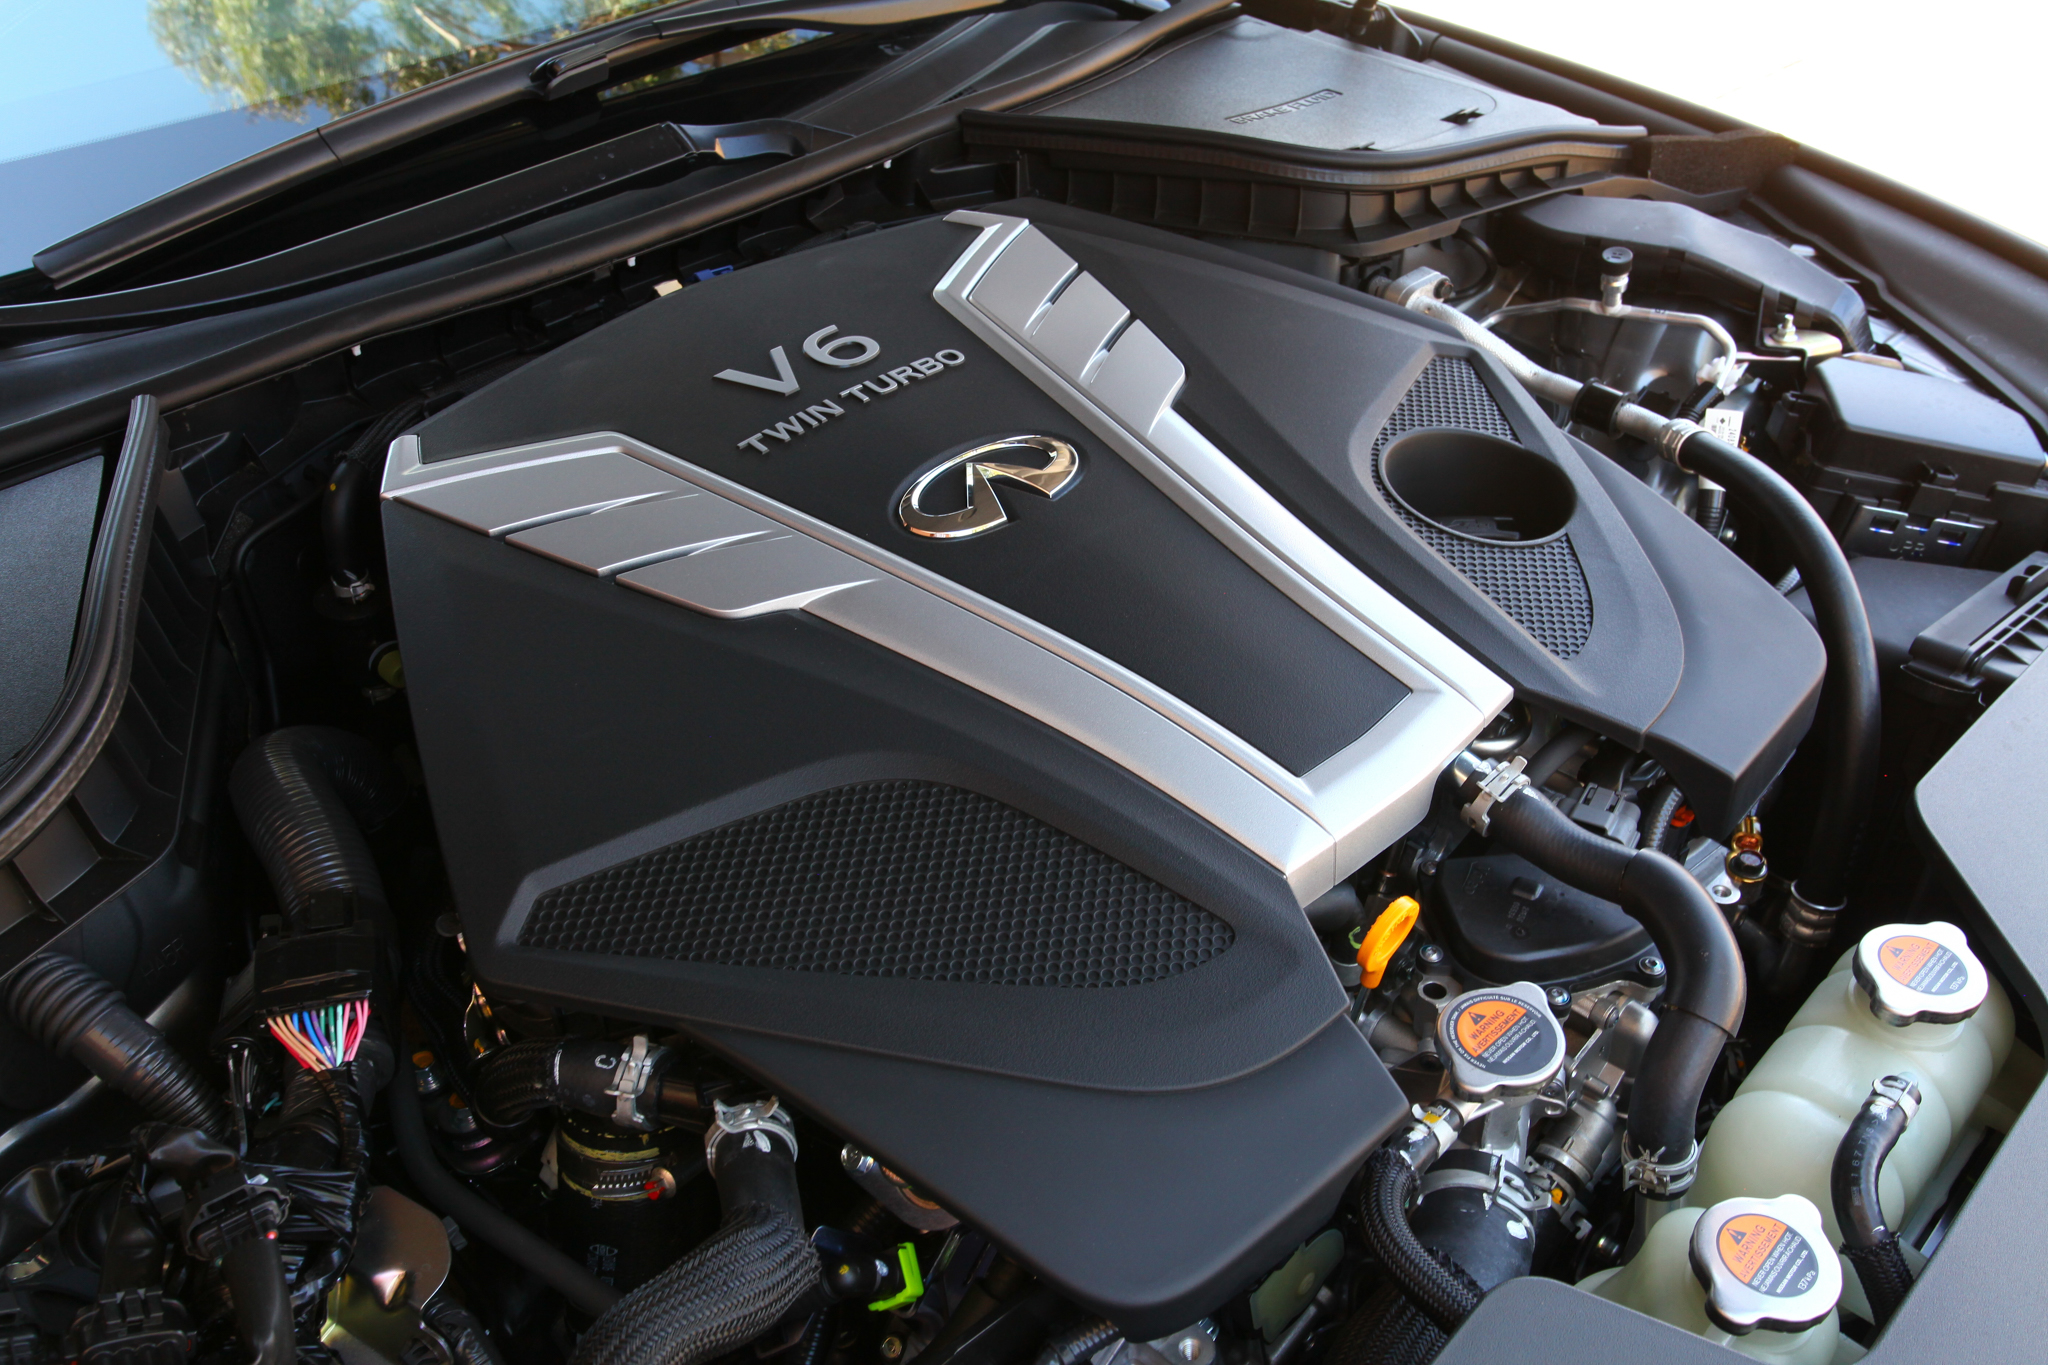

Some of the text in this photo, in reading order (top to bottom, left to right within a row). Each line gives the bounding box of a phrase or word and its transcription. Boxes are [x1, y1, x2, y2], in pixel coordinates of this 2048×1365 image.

[1230, 91, 1337, 124] BRAKE FLUID
[712, 324, 880, 396] V6
[737, 349, 965, 454] TWIN TURBO
[1893, 943, 1920, 971] WARNING
[1899, 942, 1933, 982] AVERTISSEMENT
[1469, 1010, 1505, 1040] WARNING
[1472, 1009, 1521, 1052] AVERTISSEMENT
[1482, 1016, 1530, 1059] NEVER OPEN WHEN HOT.
[1471, 1058, 1486, 1068] NEVER
[1502, 1053, 1516, 1064] NISSAN
[1514, 1042, 1527, 1054] MOTOR
[1733, 1225, 1766, 1263] WARNING
[1740, 1223, 1781, 1277] AVERTISSEMENT
[1751, 1232, 1794, 1287] NEVER OPEN WHEN HOT.
[1776, 1279, 1789, 1294] NISSAN
[1785, 1266, 1798, 1280] MOTOR
